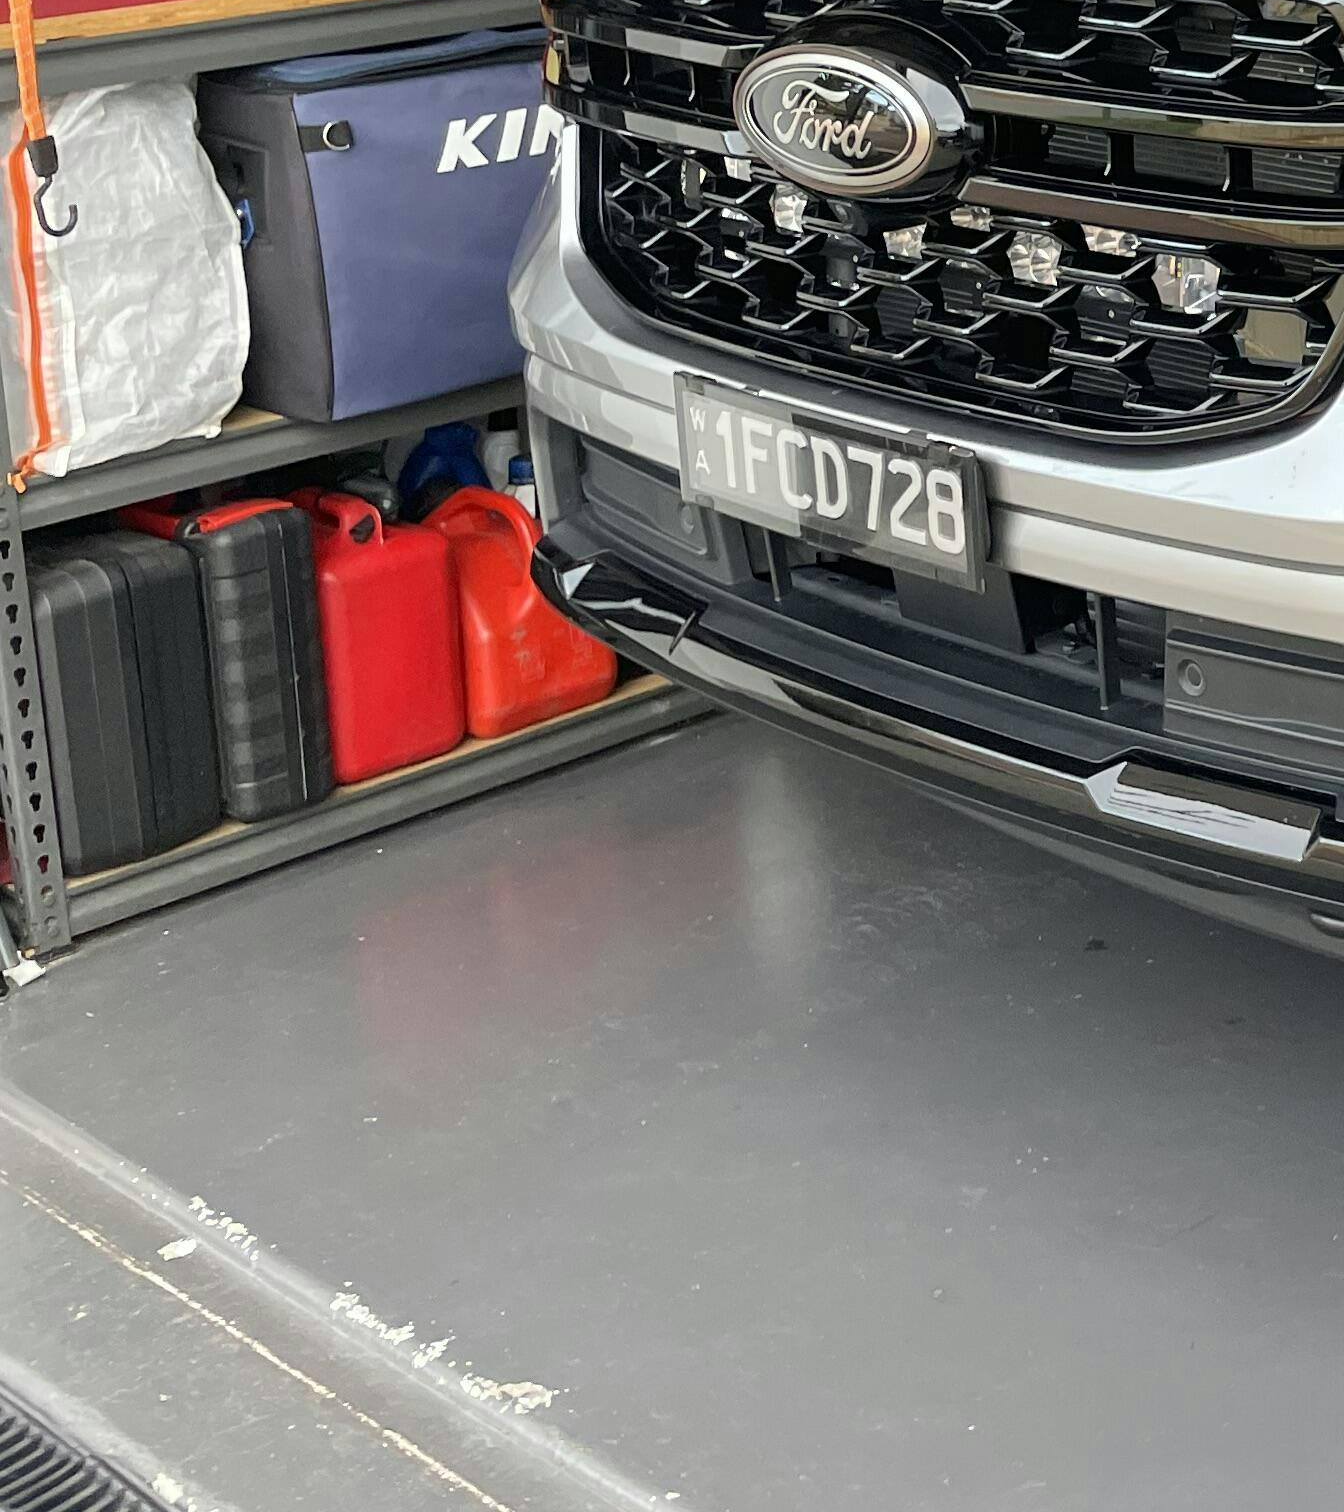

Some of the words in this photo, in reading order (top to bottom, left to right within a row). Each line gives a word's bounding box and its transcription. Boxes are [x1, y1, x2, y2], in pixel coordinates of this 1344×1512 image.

[436, 103, 565, 174] KIN
[774, 78, 875, 161] Ford
[715, 409, 967, 556] 1FCD728
